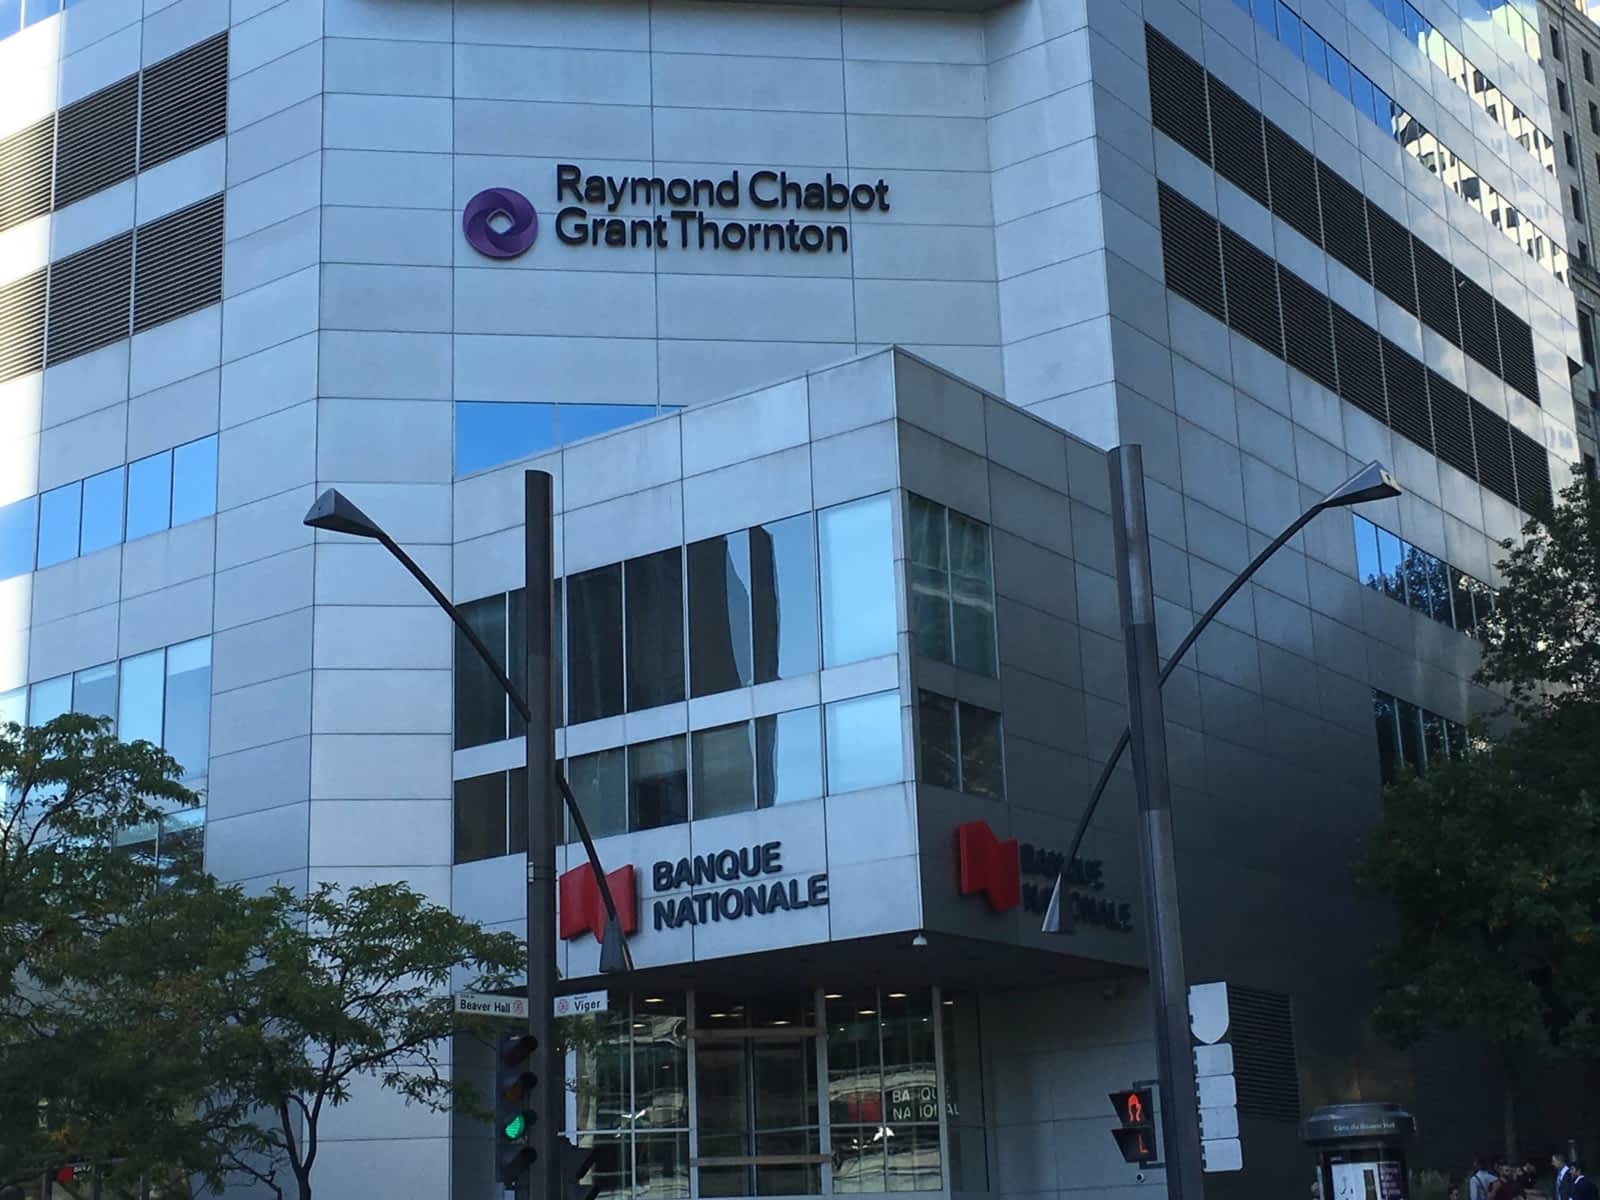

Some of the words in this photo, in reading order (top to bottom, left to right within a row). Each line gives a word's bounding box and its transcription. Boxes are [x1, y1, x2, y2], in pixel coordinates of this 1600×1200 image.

[556, 164, 739, 211] Raymond
[748, 171, 890, 211] Chabot
[555, 207, 668, 247] Grant
[671, 210, 848, 252] Thornton
[652, 841, 783, 892] BANQUE
[653, 873, 830, 931] NATIONALE
[460, 999, 491, 1012] Beaver
[494, 1002, 511, 1014] Hall
[574, 1000, 601, 1012] Viger
